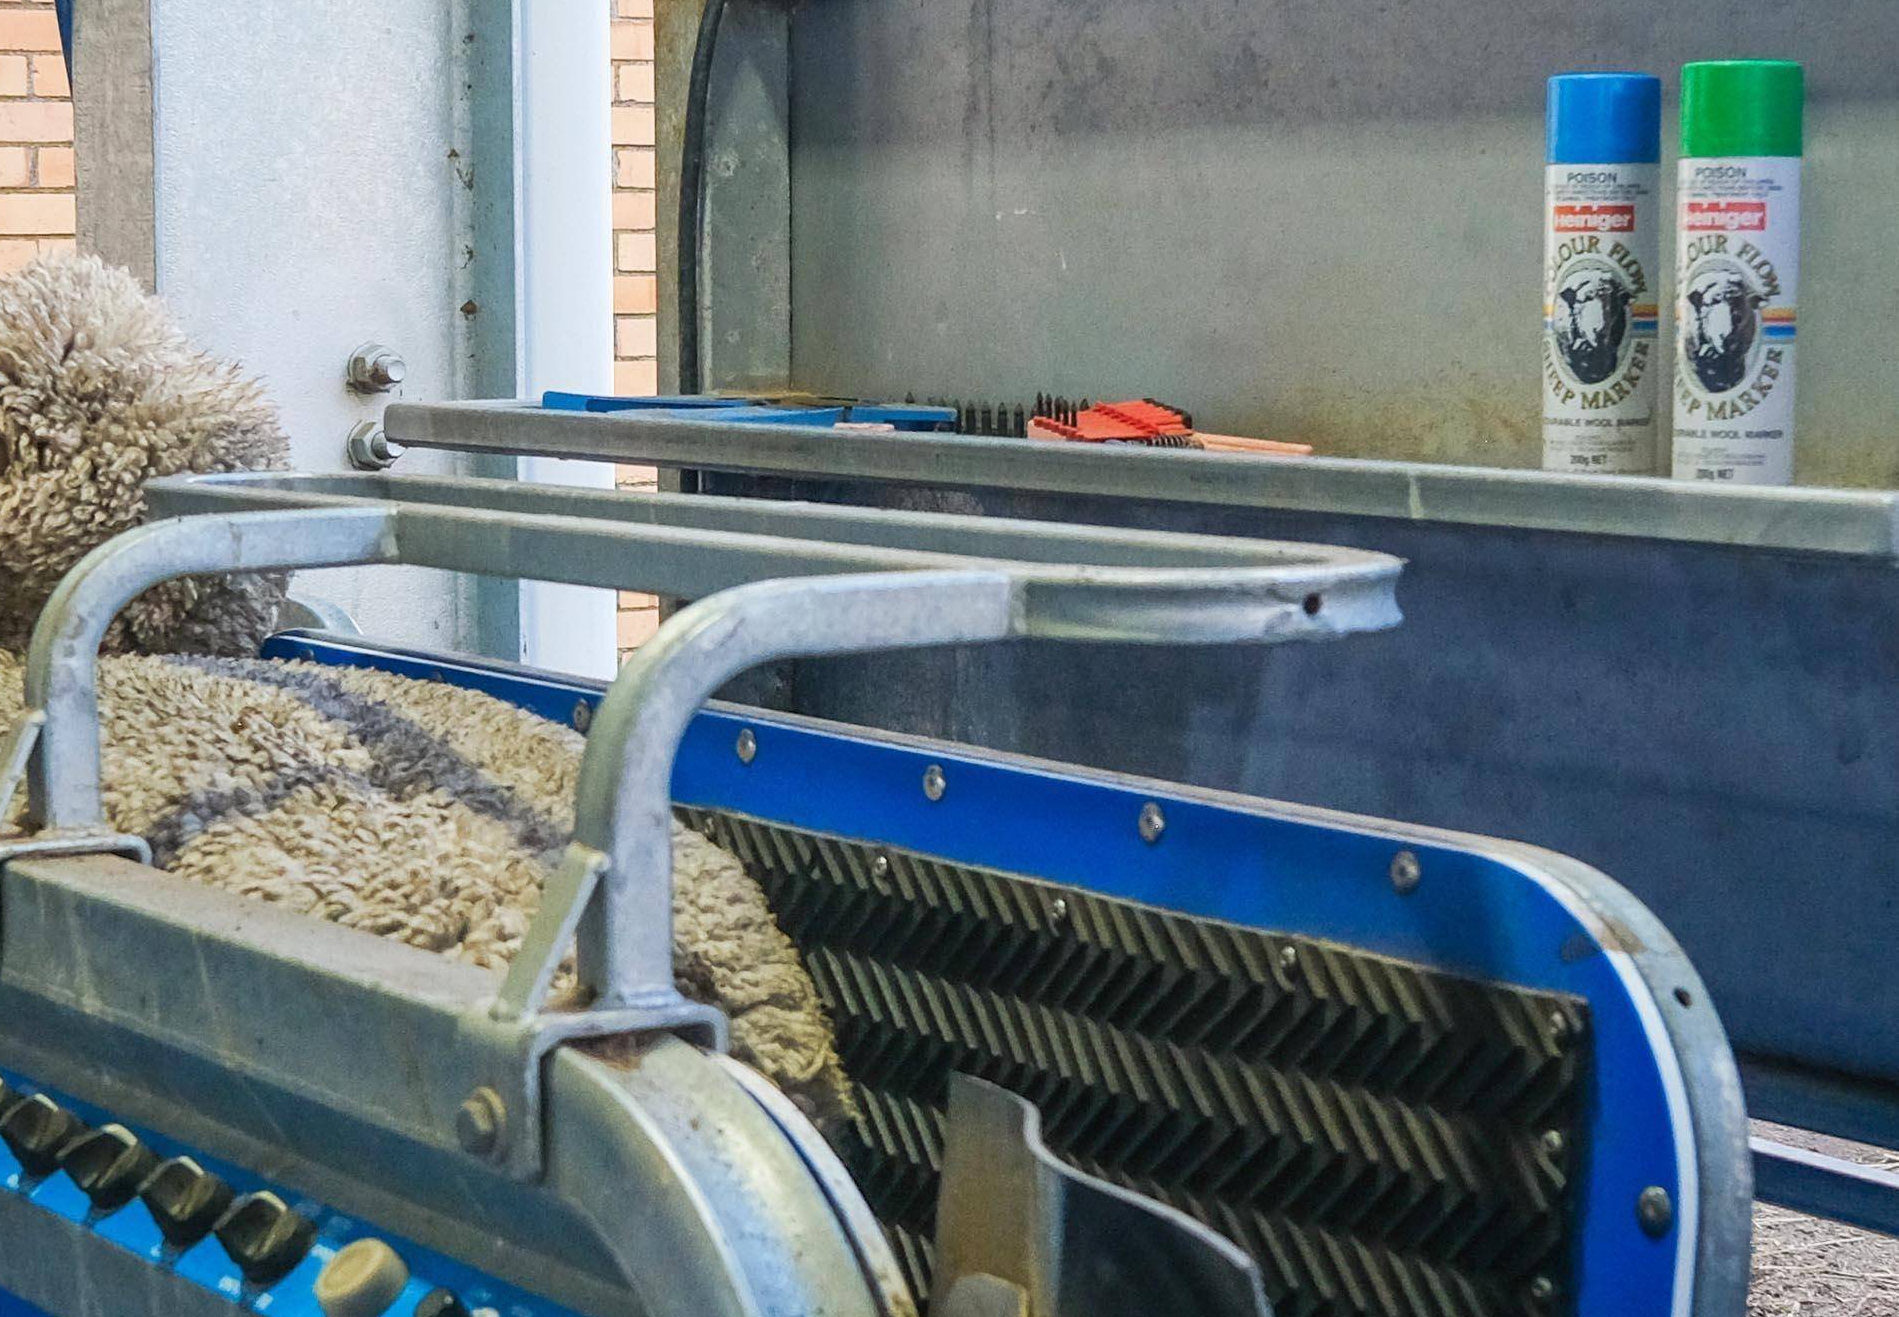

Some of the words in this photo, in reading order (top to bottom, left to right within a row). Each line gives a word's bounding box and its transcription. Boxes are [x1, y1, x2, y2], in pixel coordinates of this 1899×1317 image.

[1567, 172, 1617, 183] POISON
[1695, 166, 1747, 178] POISON
[1581, 341, 1650, 410] MARKER
[1706, 347, 1785, 421] MARKER
